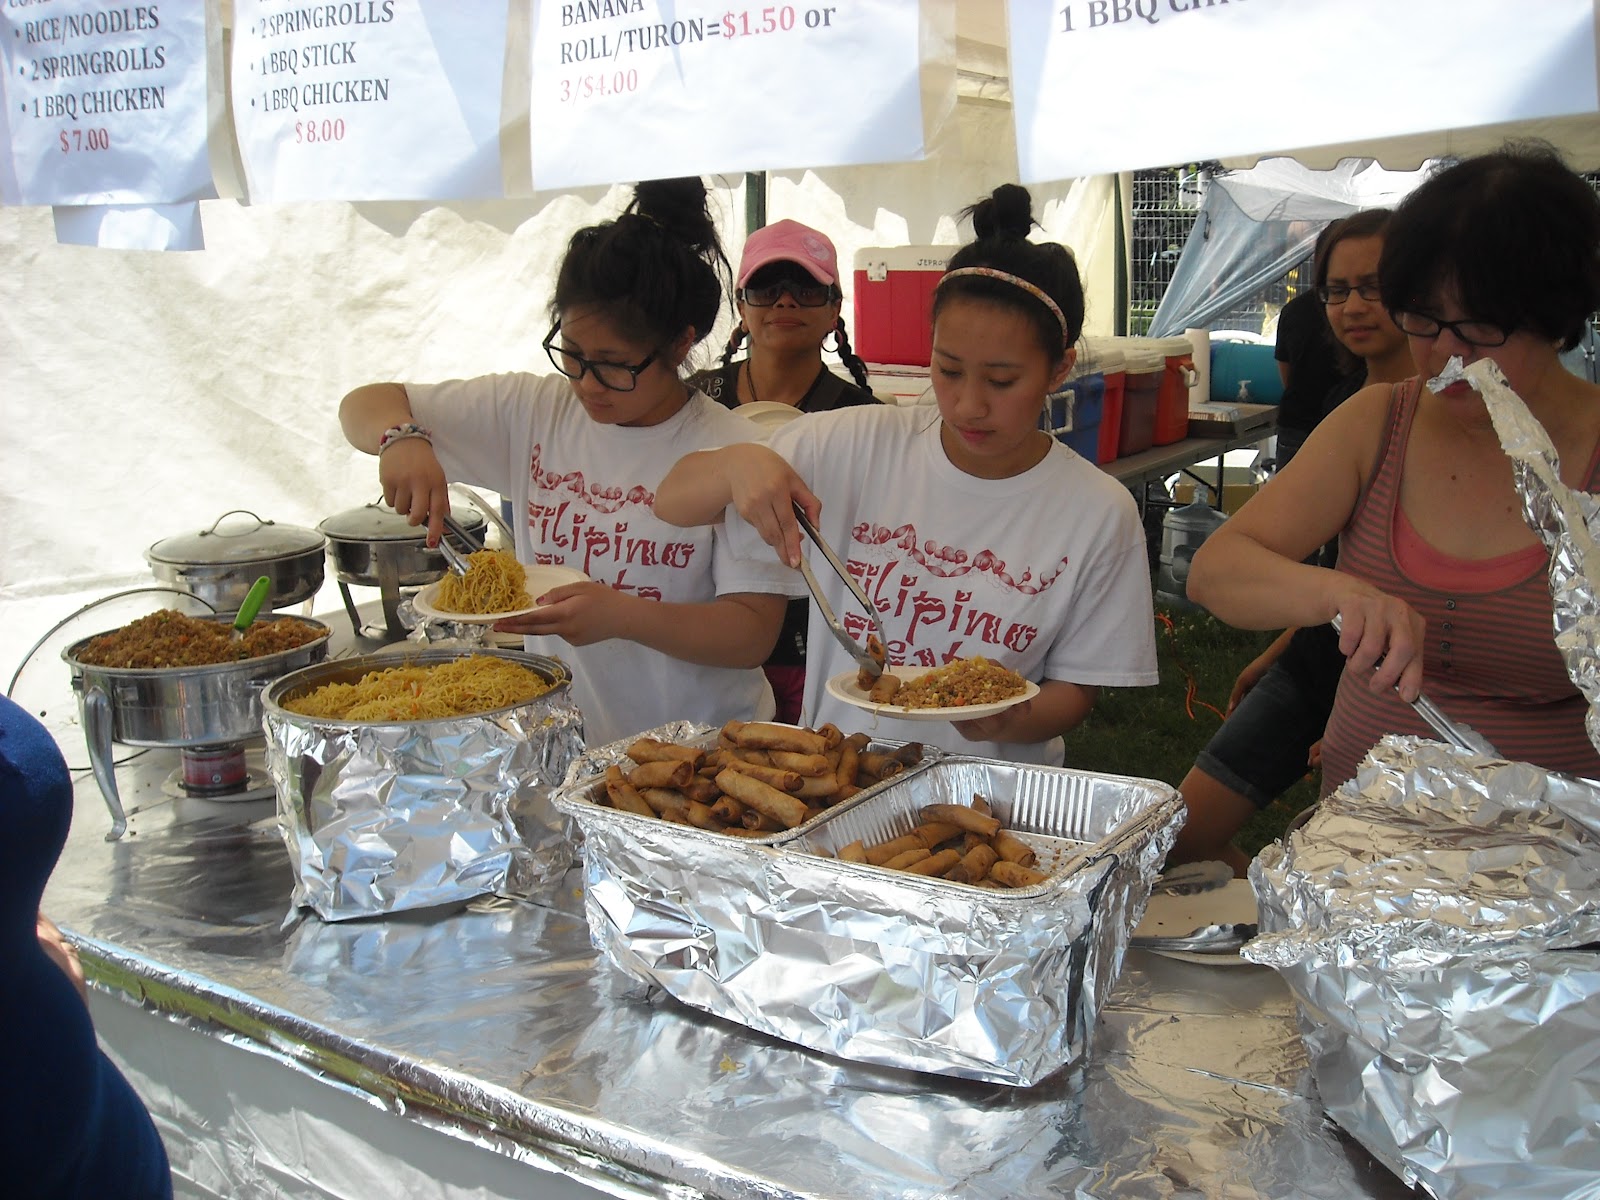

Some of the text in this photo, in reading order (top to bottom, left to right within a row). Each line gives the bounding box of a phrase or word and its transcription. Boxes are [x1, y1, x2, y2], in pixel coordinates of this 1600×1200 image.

[25, 6, 159, 44] RICE/NOODLES
[260, 0, 395, 39] 2 SPRINGROLLS
[561, 0, 645, 27] BANANA
[804, 6, 836, 28] or
[1059, 5, 1077, 32] 1
[1088, 0, 1160, 28] BBQ
[31, 46, 166, 81] 2 SPRINGROLLS
[261, 41, 357, 75] 1 BBQ STICK
[33, 86, 166, 120] 1 BBQ CHICKEN
[263, 78, 390, 112] 1 BBQ CHICKEN
[560, 69, 638, 106] 3/$4.00
